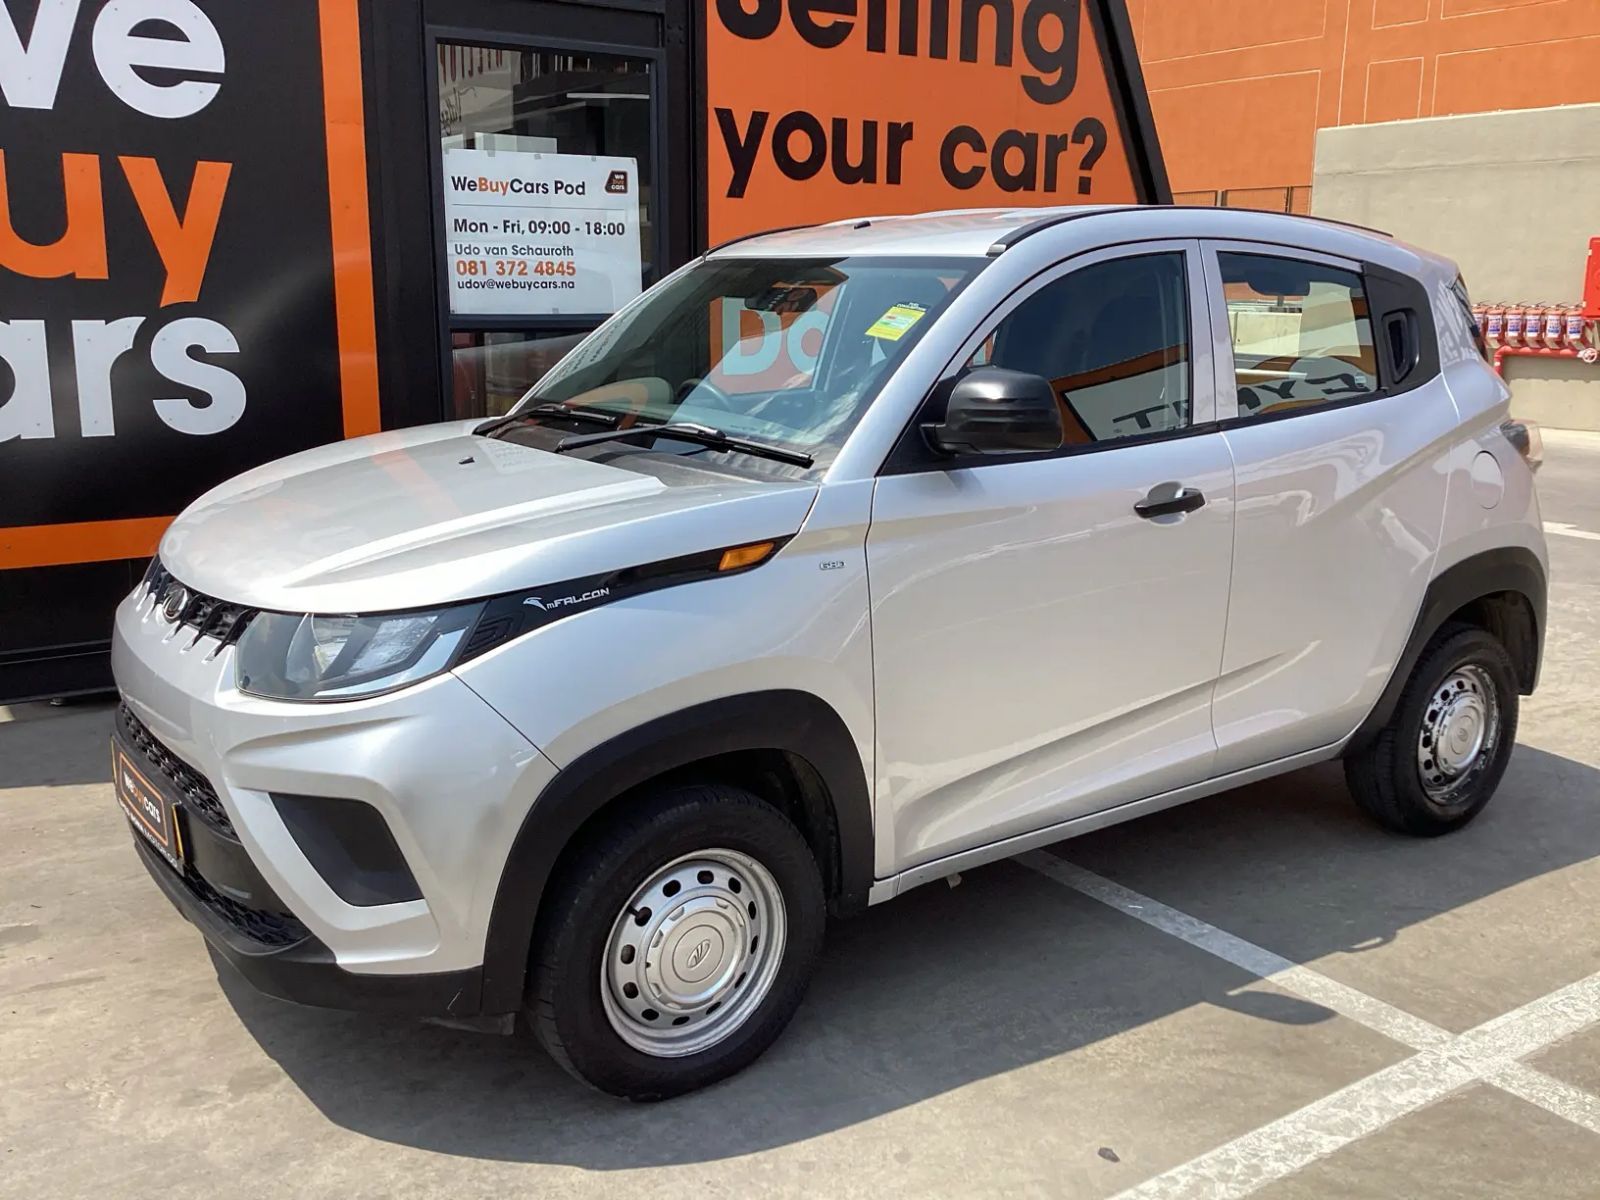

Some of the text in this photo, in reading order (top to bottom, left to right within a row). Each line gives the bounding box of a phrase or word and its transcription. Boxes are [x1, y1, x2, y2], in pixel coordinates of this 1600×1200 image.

[714, 107, 1108, 199] your car?
[450, 175, 586, 196] WeBuyCars Pod
[453, 218, 489, 233] Mon
[503, 219, 525, 235] Fri,
[528, 220, 571, 235] 09:00
[584, 221, 626, 236] 18:00
[454, 243, 574, 257] Udo van Schauroth
[456, 260, 577, 277] 081 372 4845
[457, 278, 576, 292] udov@webuycars.na
[546, 587, 610, 609] mFALCON
